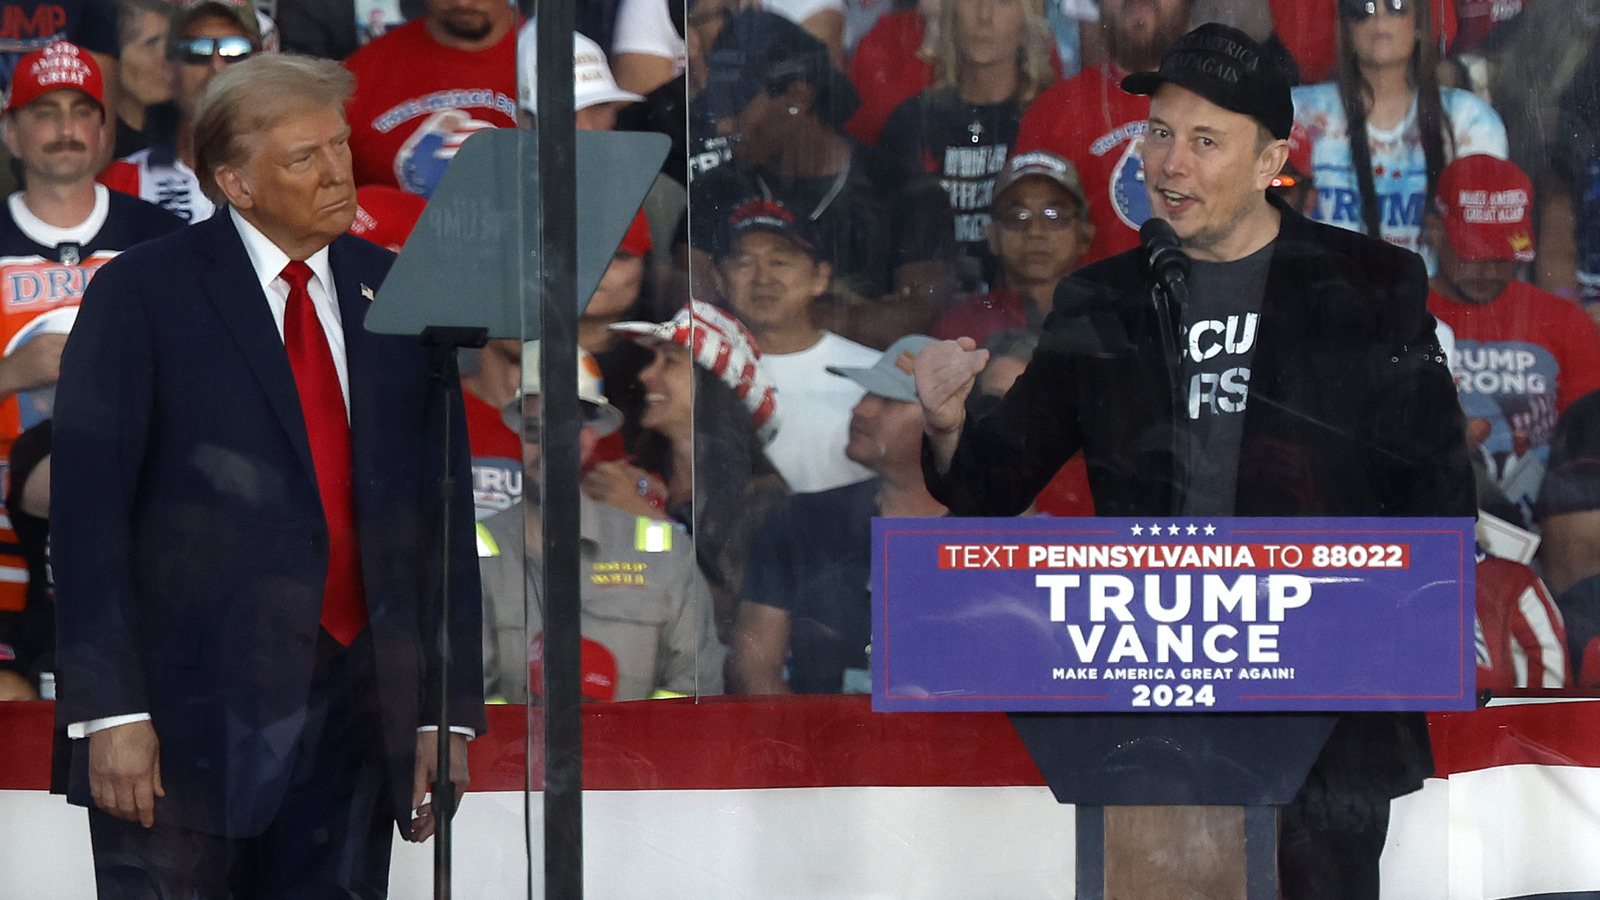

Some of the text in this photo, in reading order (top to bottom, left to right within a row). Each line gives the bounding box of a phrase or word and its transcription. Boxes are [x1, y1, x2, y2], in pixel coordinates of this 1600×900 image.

[945, 545, 1403, 568] TEXT PENNSYLVANIA TO 88022
[1035, 574, 1313, 622] TRUMP
[1067, 624, 1280, 663] VANCE
[1053, 668, 1295, 680] MAKE AMERICA GREAT AGAIN!
[1132, 684, 1216, 707] 2024
